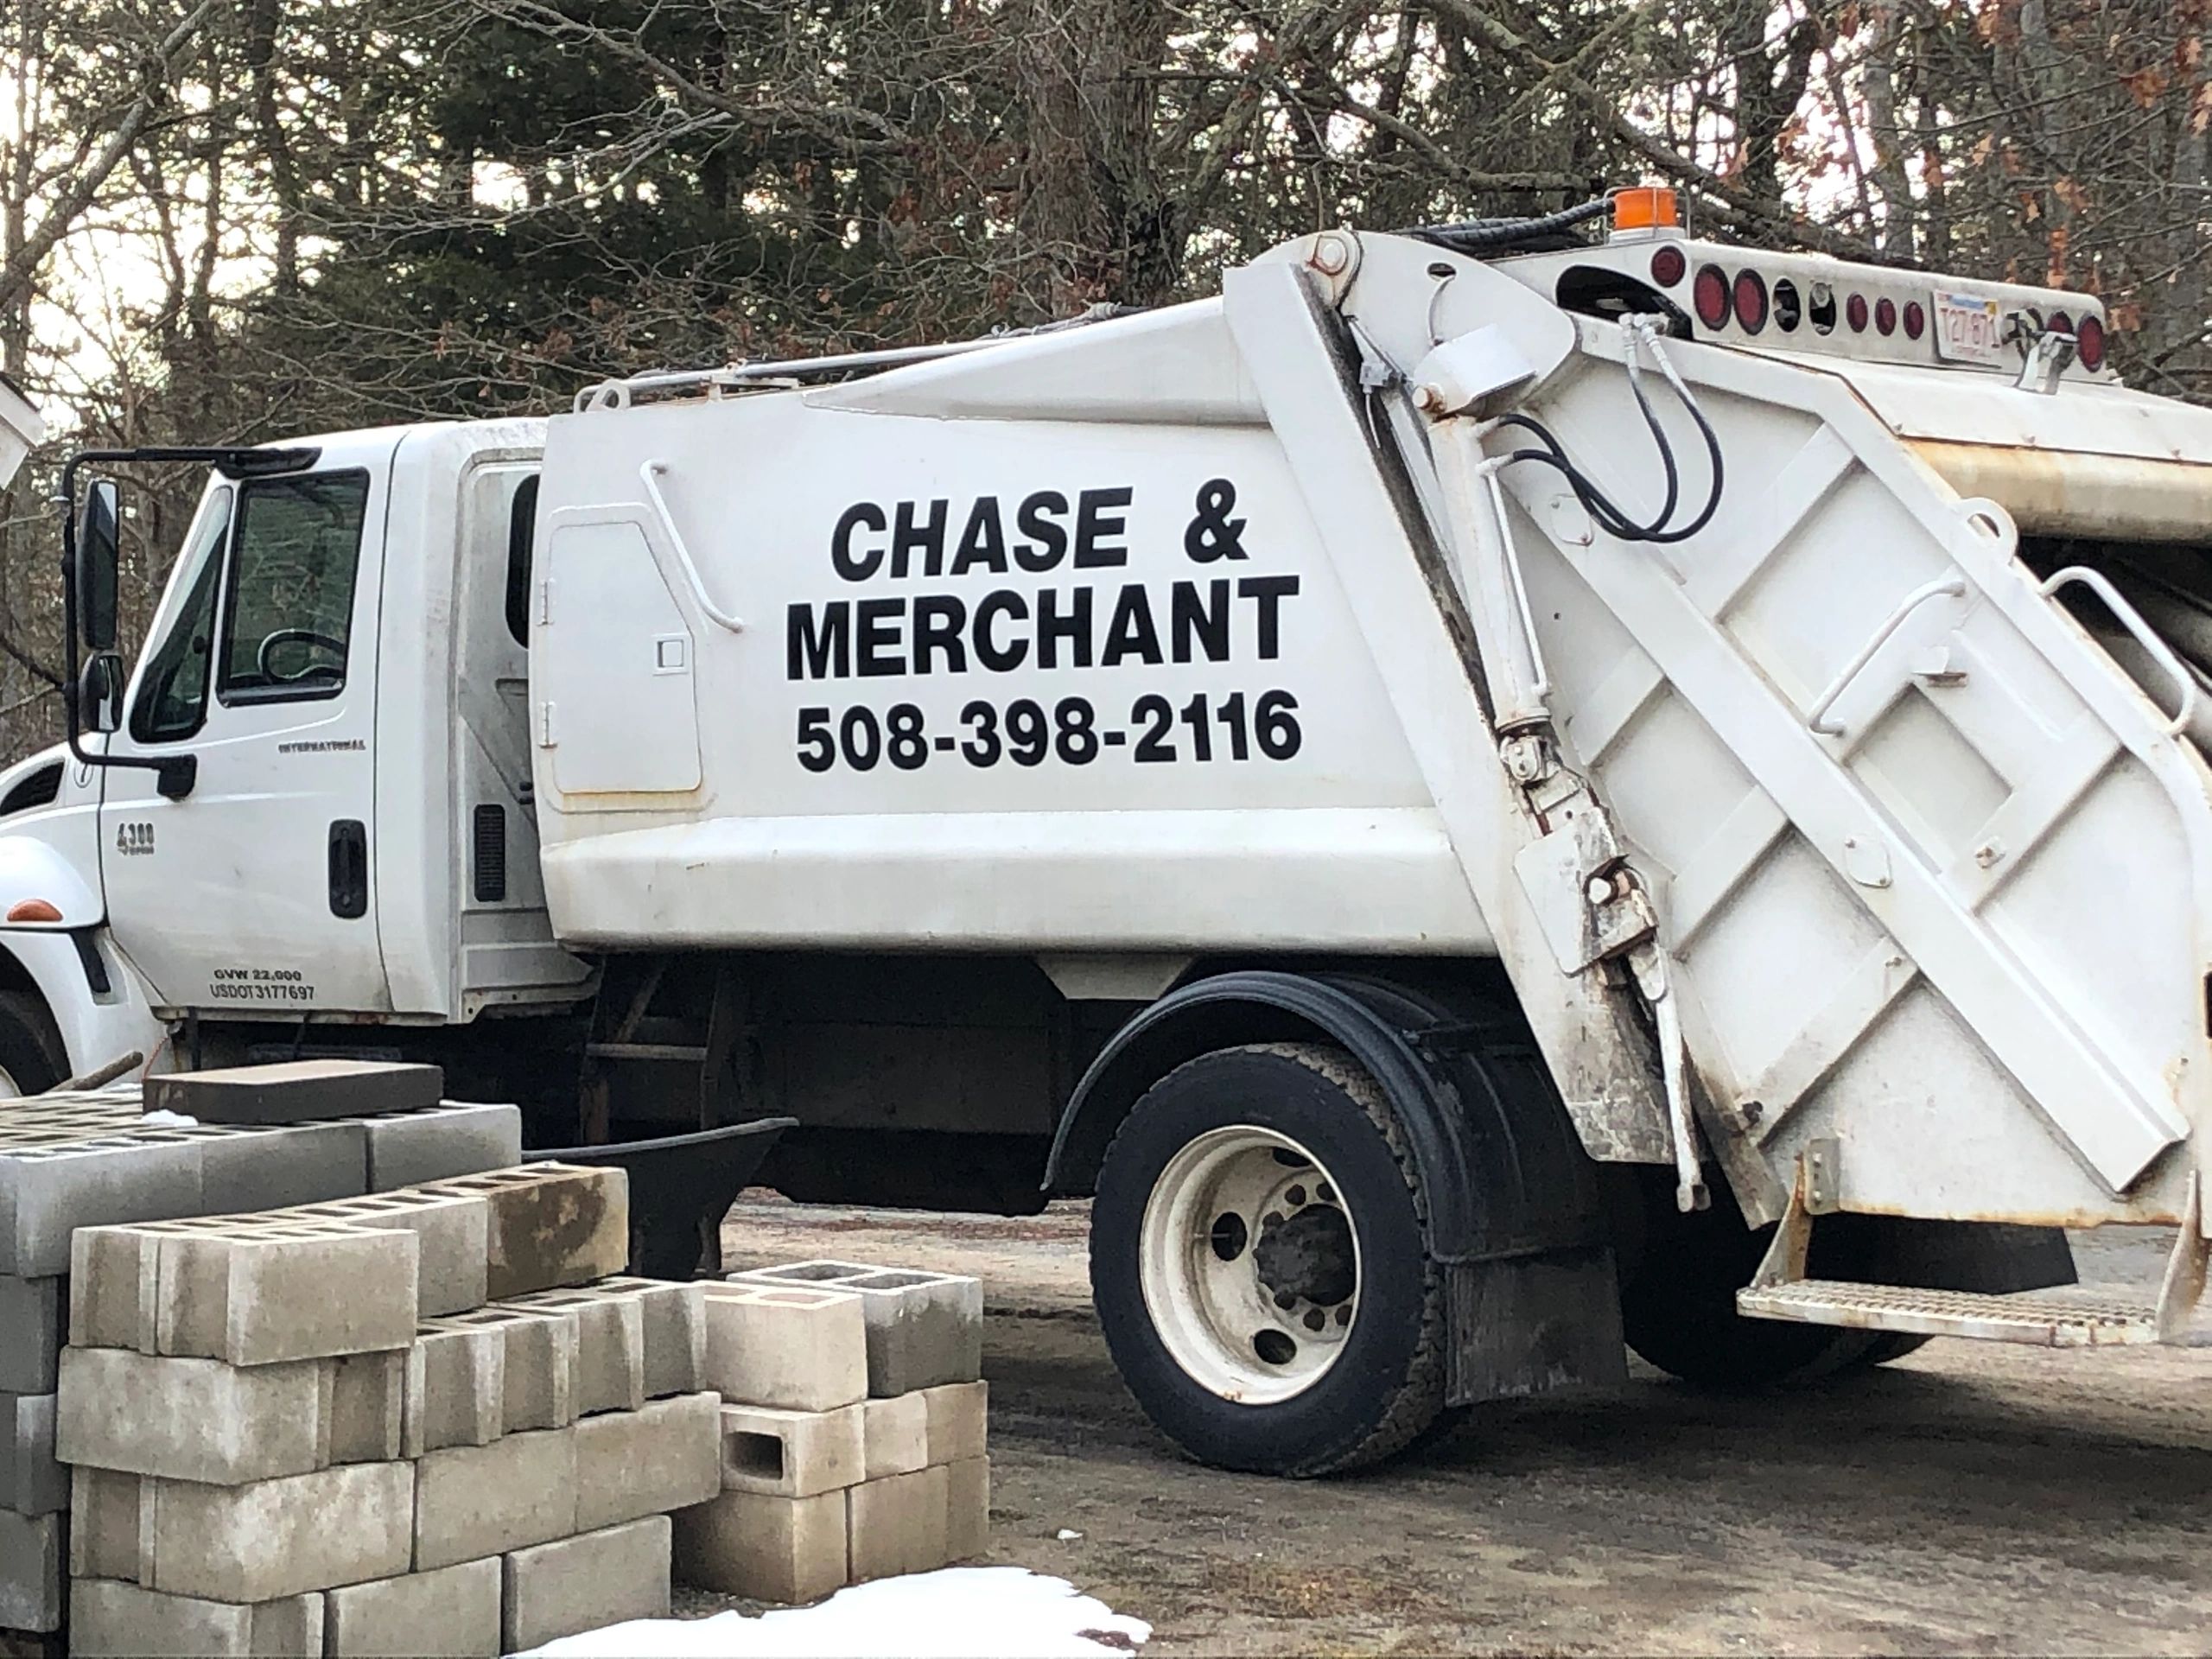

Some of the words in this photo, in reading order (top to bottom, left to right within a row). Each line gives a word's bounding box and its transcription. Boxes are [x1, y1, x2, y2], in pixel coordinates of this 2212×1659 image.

[831, 486, 1133, 582] CHASE
[1184, 479, 1249, 563] &
[787, 575, 1300, 681] MERCHANT
[798, 690, 1302, 772] 508-398-2116
[117, 823, 155, 852] 4300
[213, 969, 248, 979] GVW
